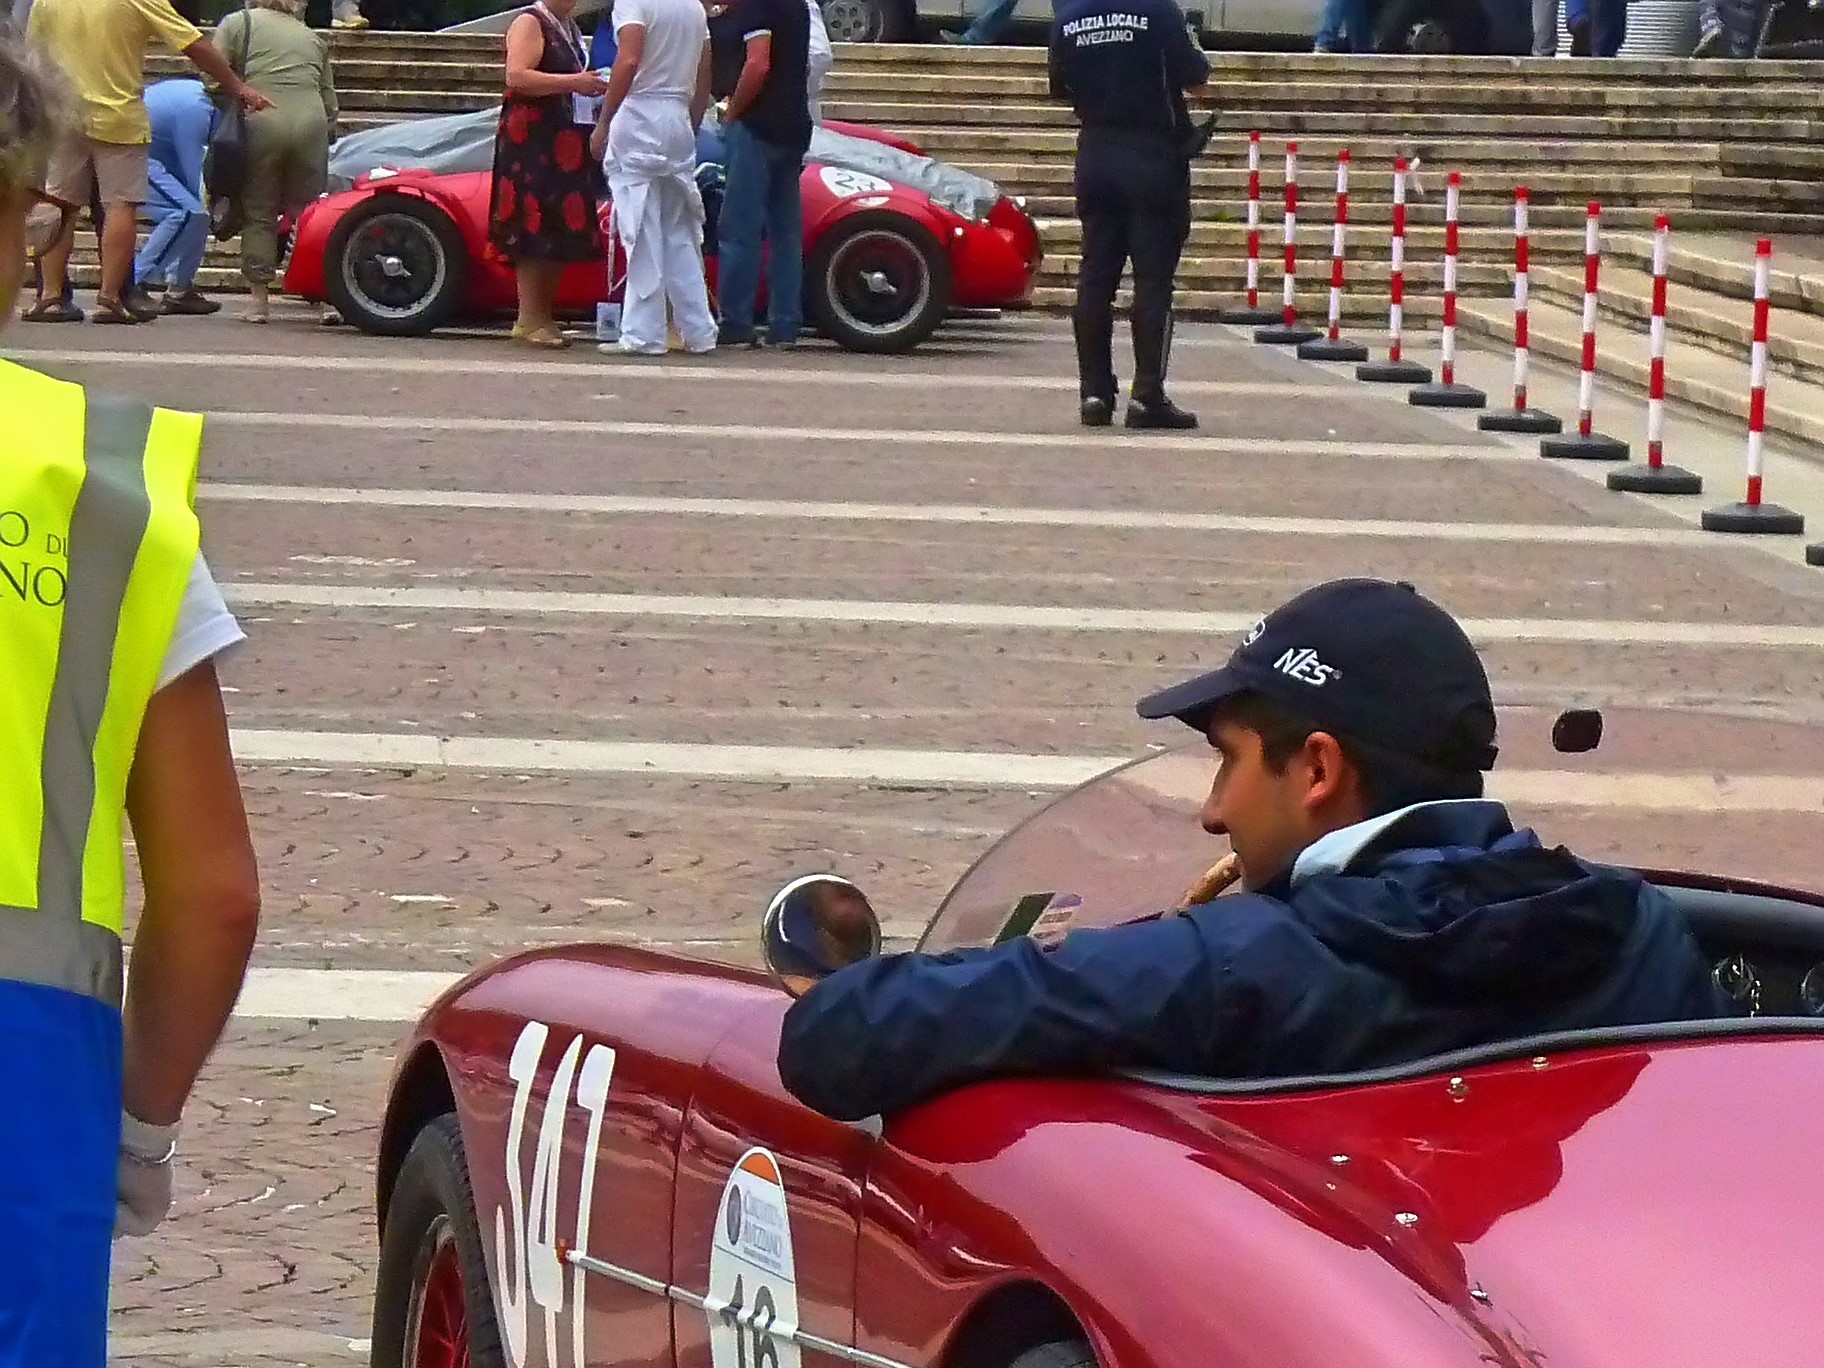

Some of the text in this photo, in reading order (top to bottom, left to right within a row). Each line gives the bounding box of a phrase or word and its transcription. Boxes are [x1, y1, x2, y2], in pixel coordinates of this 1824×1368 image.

[1063, 13, 1148, 36] POLIZIA LOCALE
[1076, 29, 1134, 47] AVEZZANO
